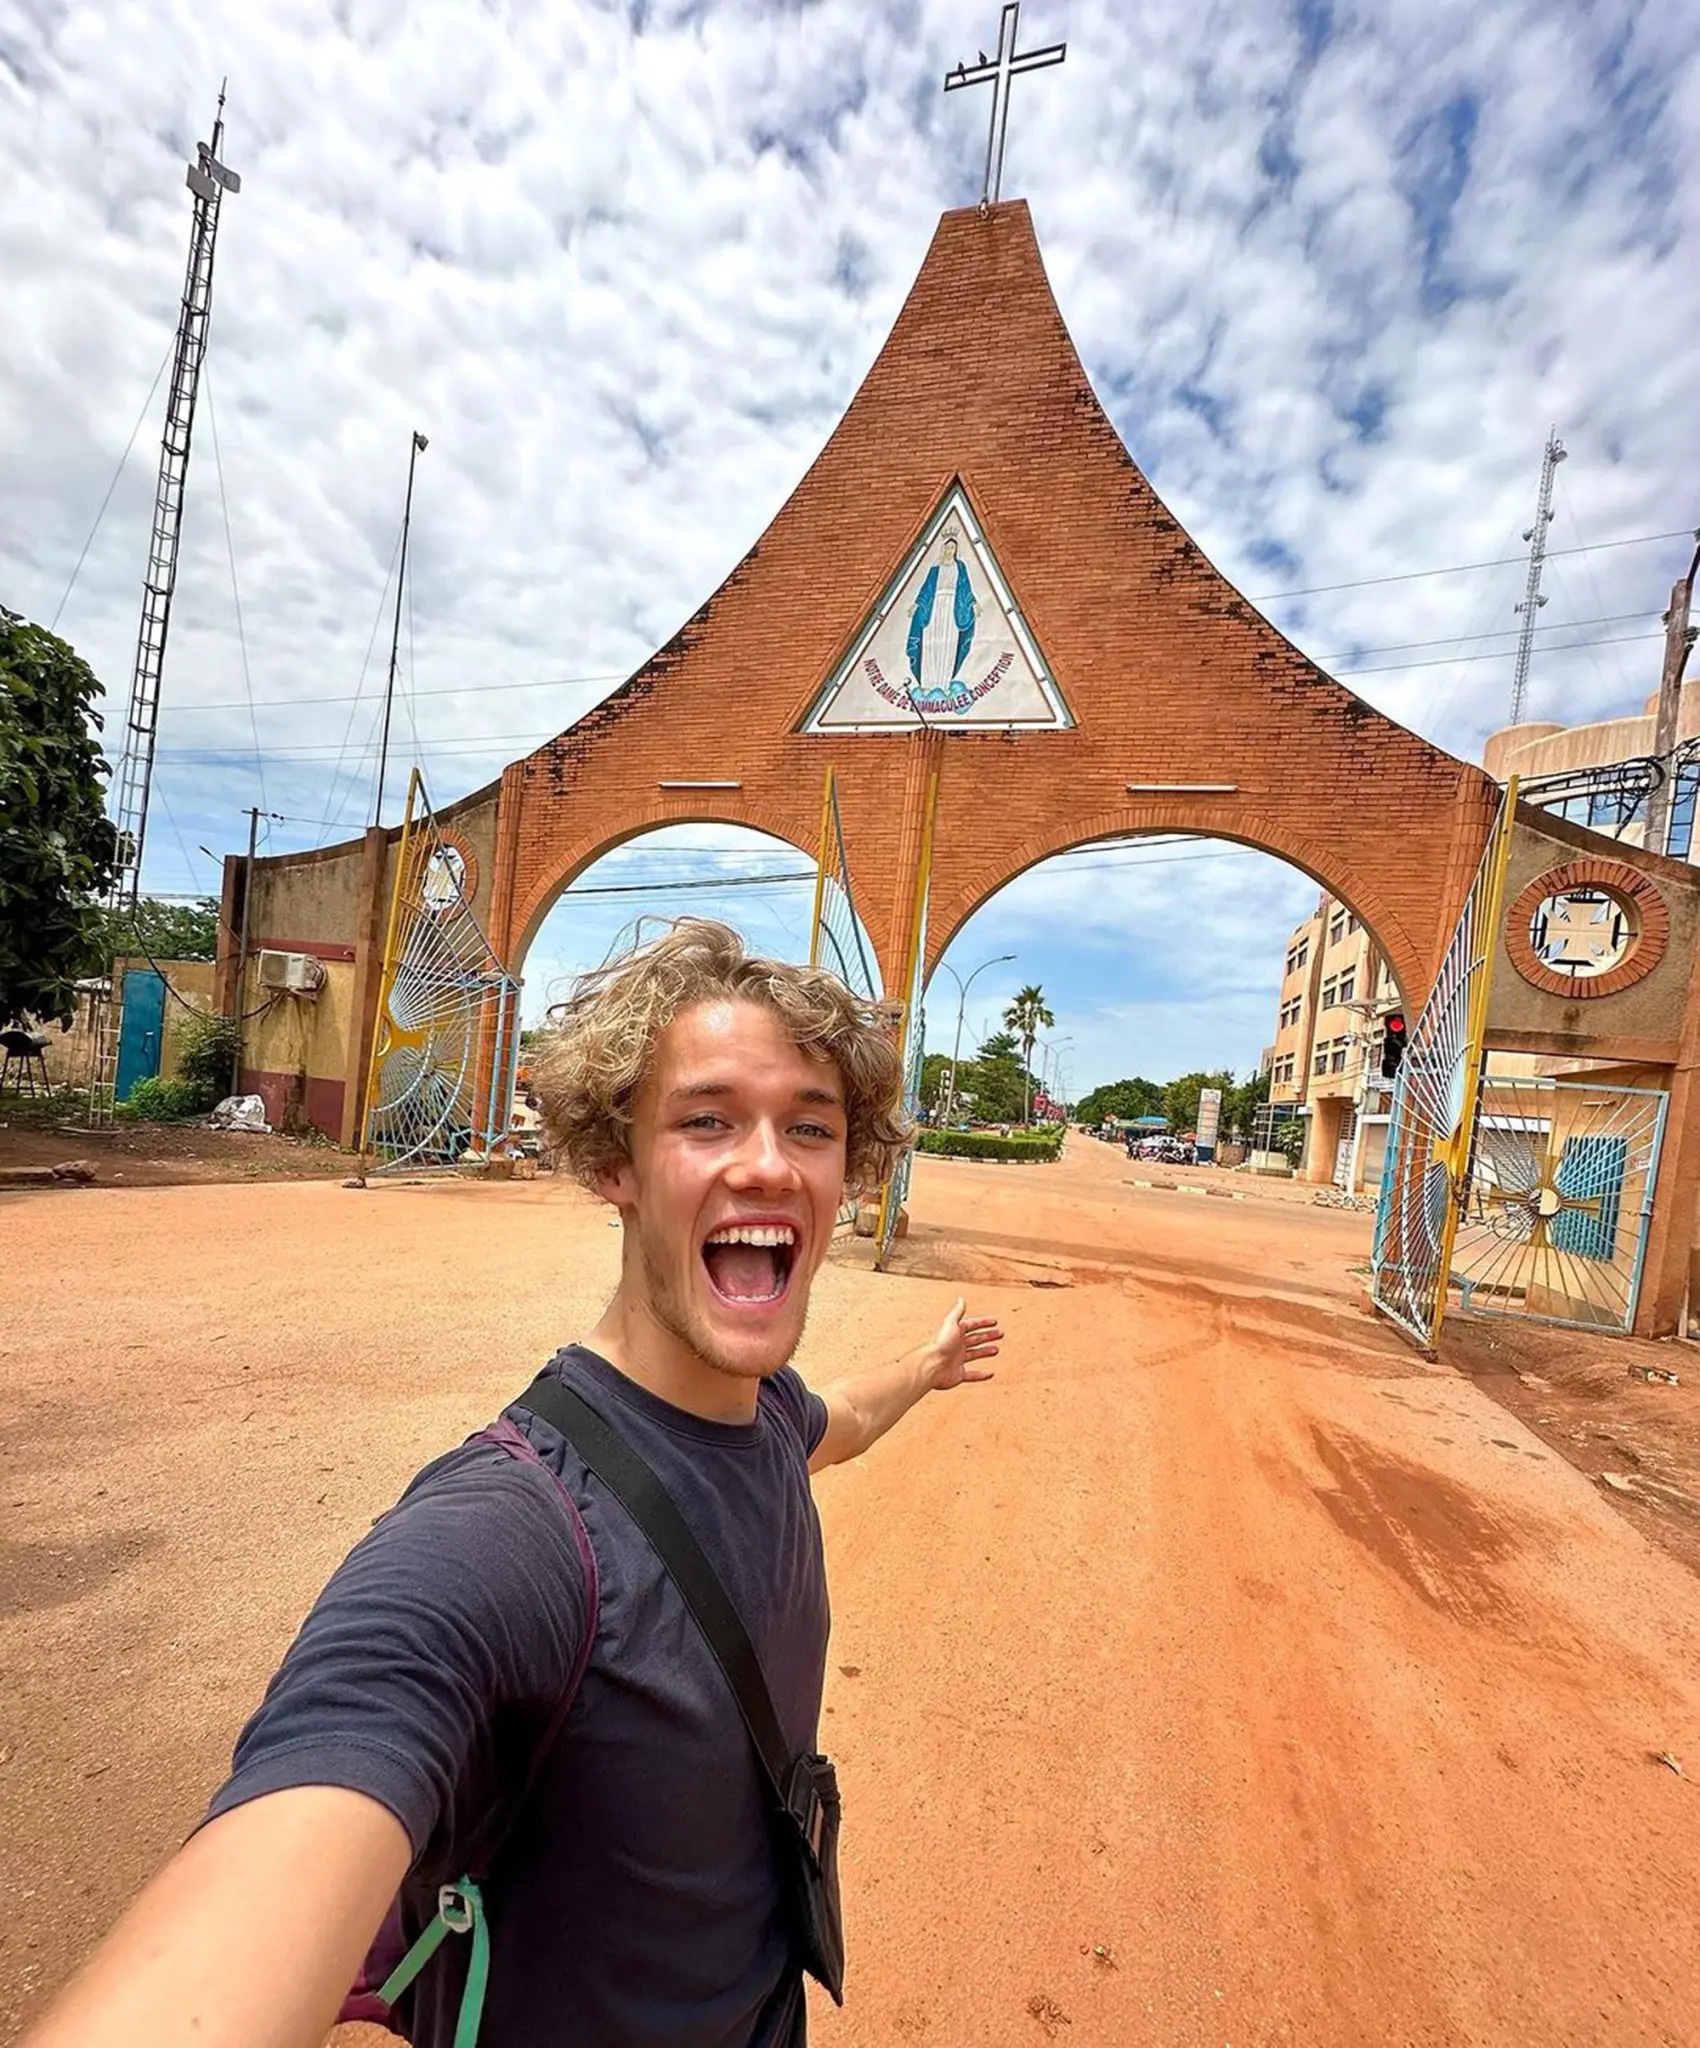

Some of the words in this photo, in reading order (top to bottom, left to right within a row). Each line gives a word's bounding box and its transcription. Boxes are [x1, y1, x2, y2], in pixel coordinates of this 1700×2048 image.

[864, 658, 884, 687] NOTRE
[876, 682, 901, 704] DAME
[896, 695, 909, 710] DE
[969, 651, 1015, 701] CONCEPTION
